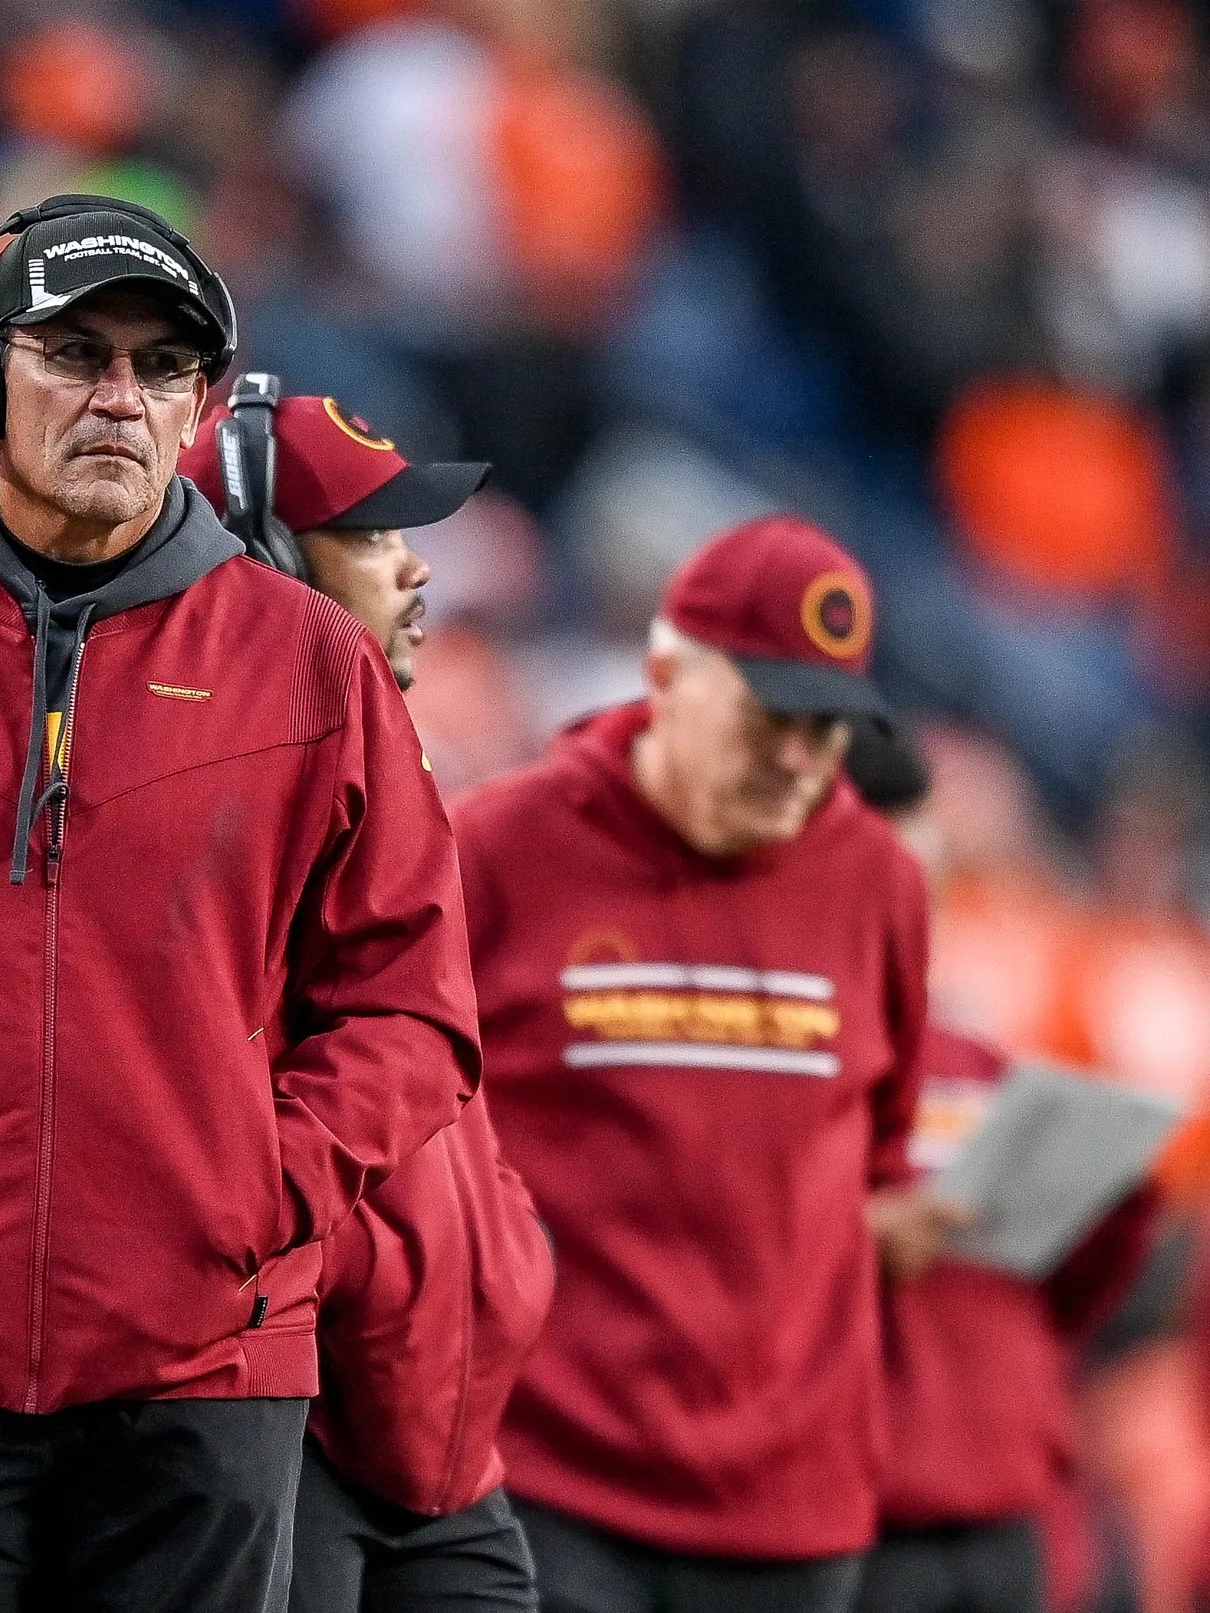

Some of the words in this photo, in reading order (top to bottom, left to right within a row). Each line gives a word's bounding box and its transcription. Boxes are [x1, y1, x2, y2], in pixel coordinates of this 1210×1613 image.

[43, 235, 189, 280] WASHINGTON
[64, 247, 113, 262] FOOTBALL
[149, 684, 210, 697] WASHINGTON
